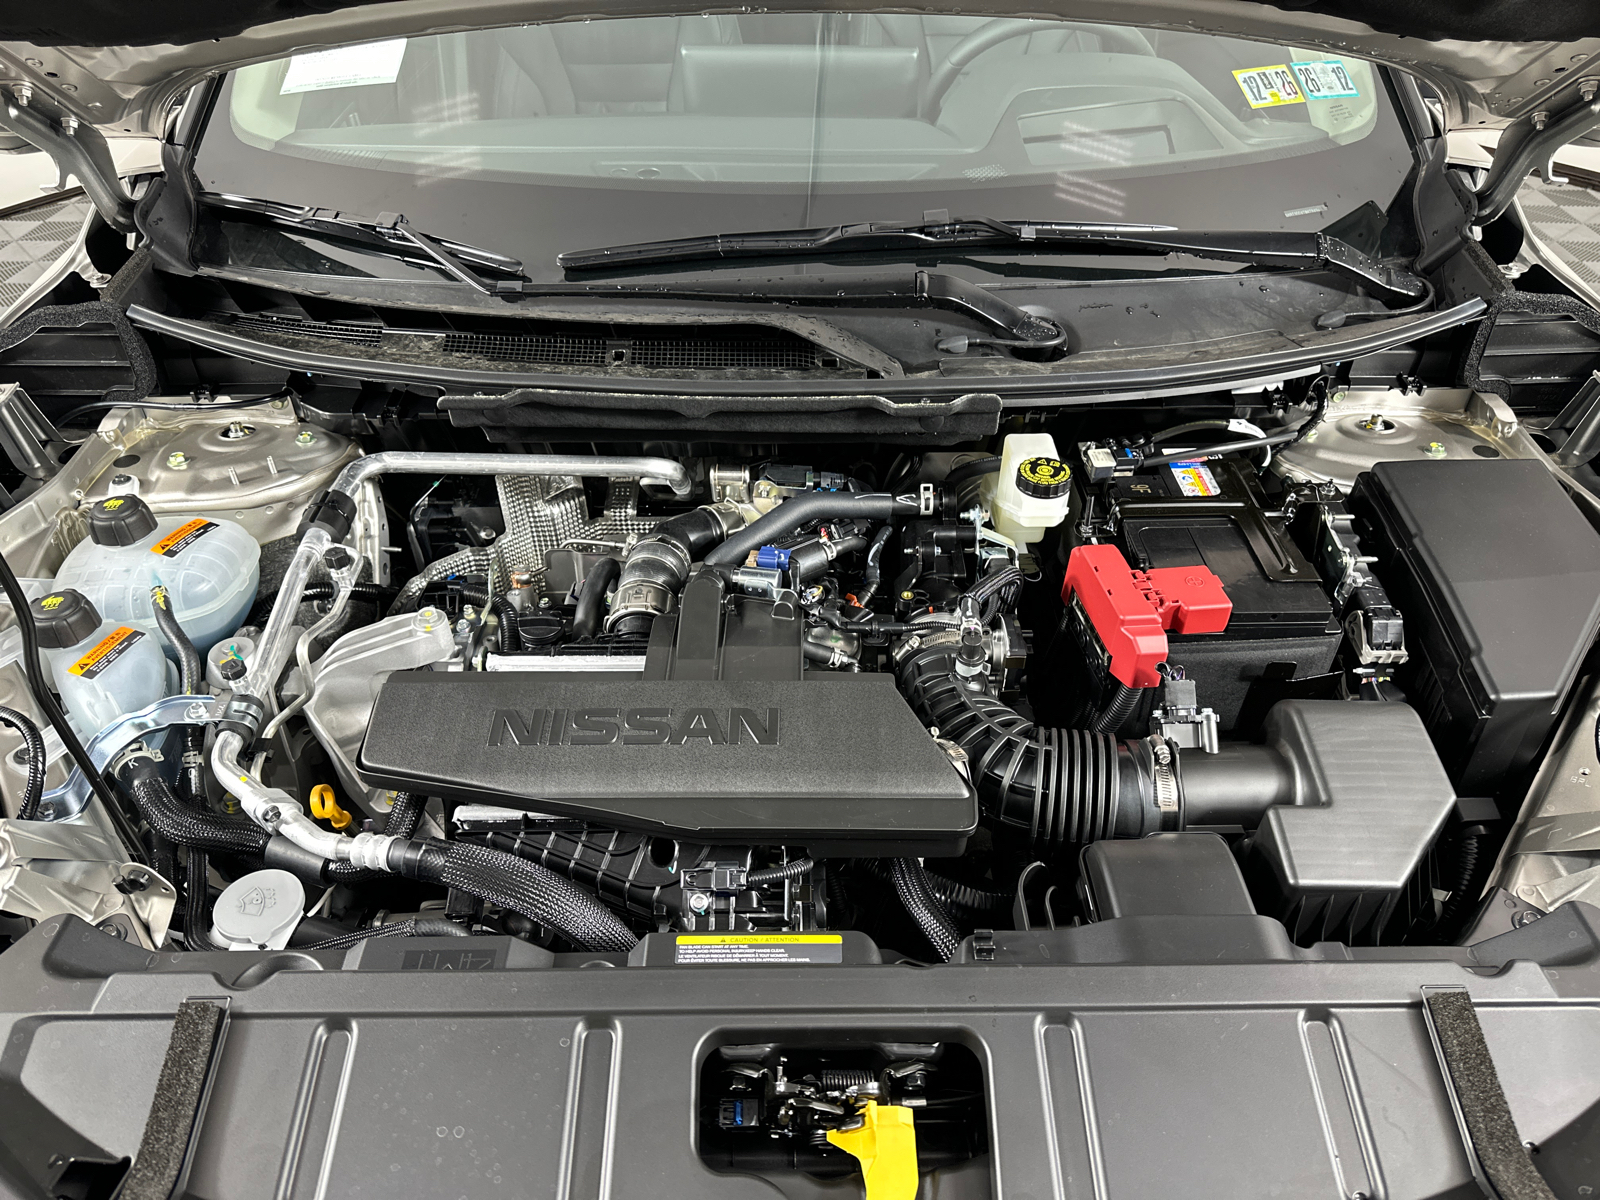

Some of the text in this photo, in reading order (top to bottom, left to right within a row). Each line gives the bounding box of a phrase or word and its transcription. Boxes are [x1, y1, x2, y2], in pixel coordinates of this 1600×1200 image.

[1242, 76, 1267, 101] 12
[1275, 70, 1298, 96] 26
[1298, 67, 1321, 93] 26
[1331, 66, 1354, 91] 12
[86, 641, 109, 660] WARNING
[487, 708, 780, 746] NISSAN
